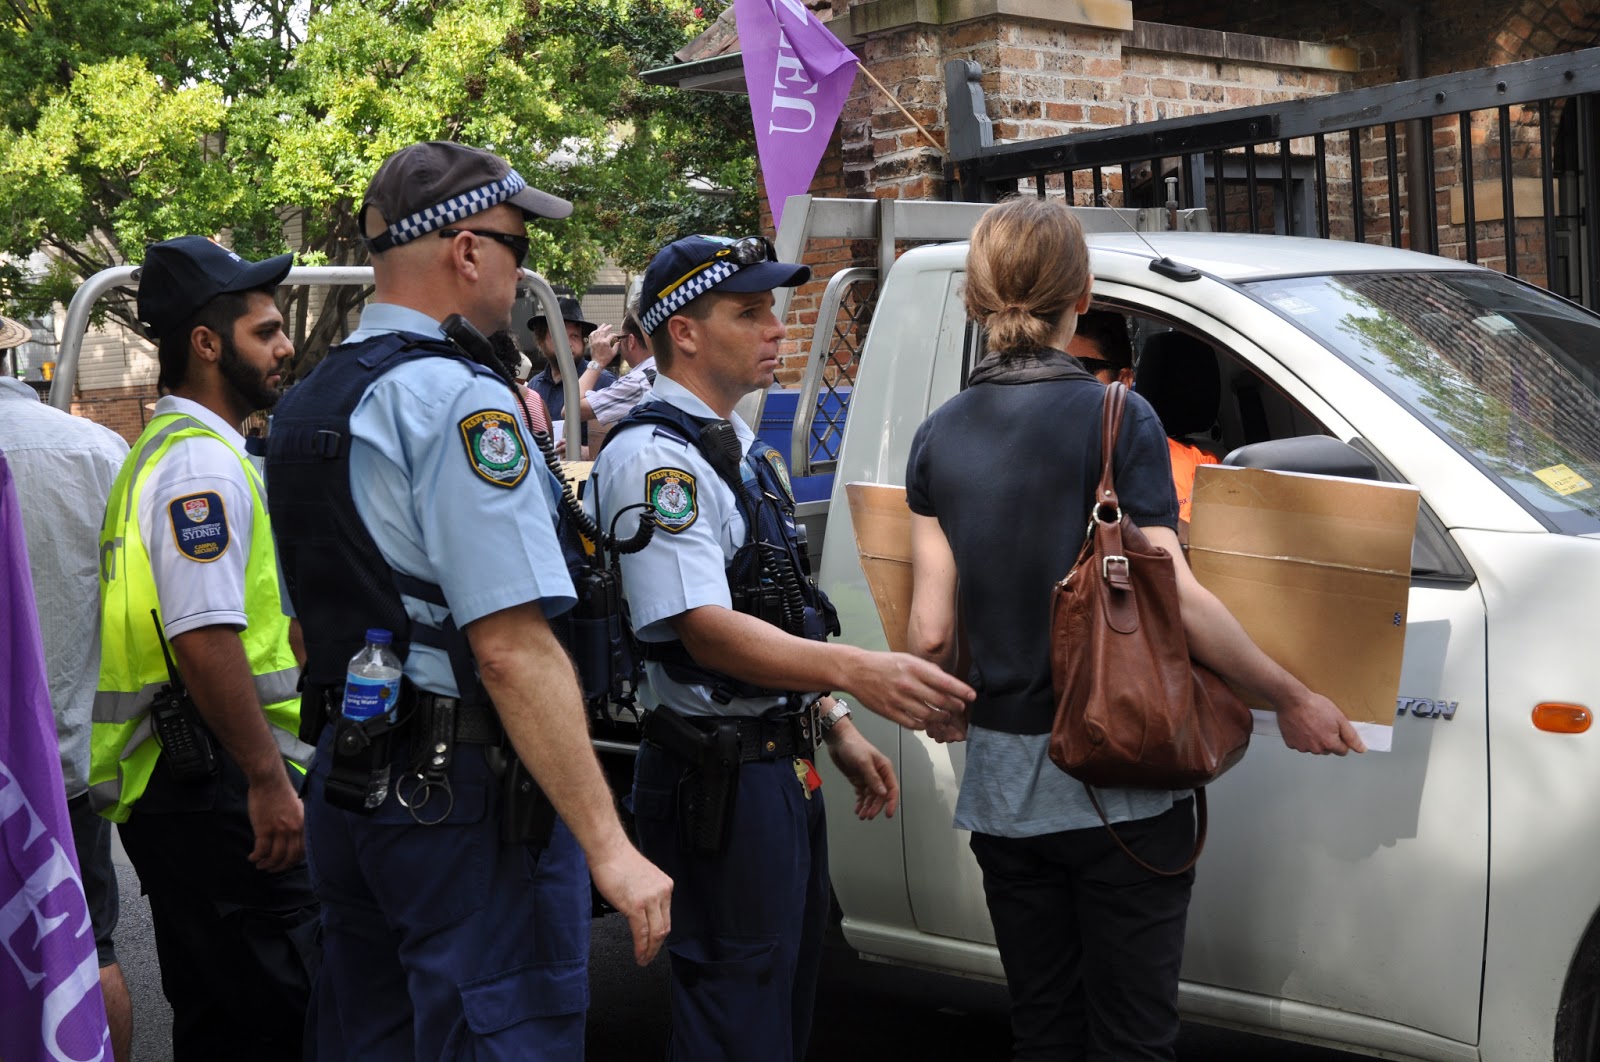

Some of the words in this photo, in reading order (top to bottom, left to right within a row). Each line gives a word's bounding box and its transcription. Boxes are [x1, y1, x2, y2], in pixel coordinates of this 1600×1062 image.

[484, 414, 512, 424] POLICE
[669, 471, 692, 484] POLICE
[182, 526, 222, 541] SYDNEY
[194, 542, 217, 550] CAMPUS
